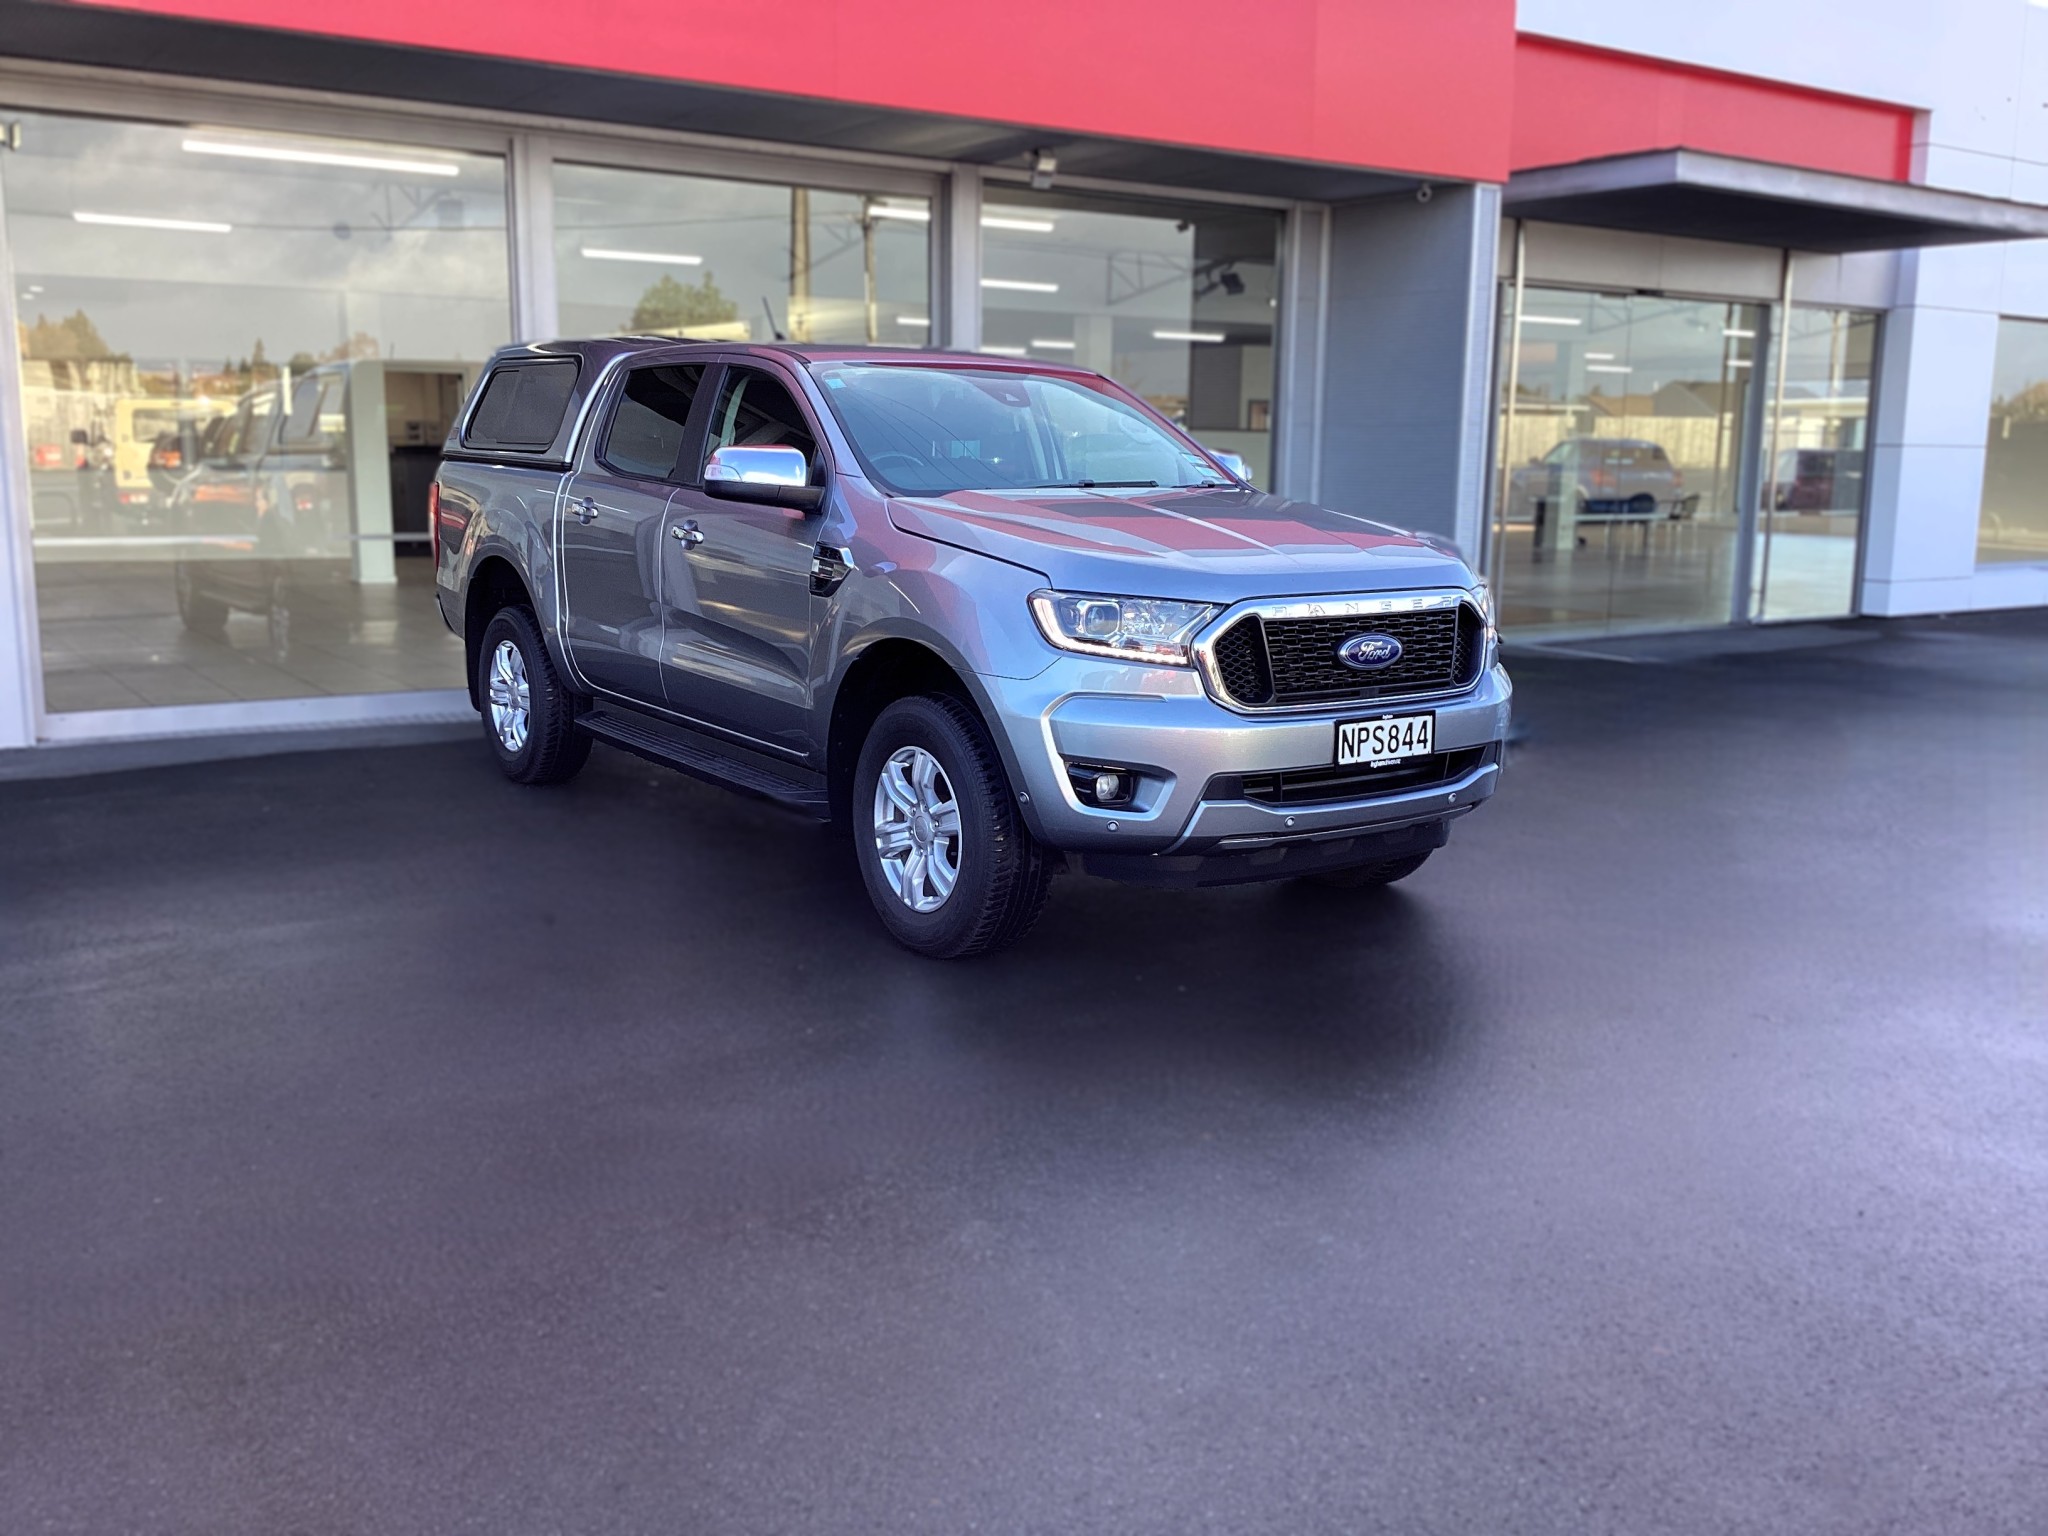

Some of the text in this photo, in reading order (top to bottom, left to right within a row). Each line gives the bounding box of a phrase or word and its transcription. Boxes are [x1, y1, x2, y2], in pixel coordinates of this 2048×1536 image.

[1272, 596, 1453, 616] RANGER
[1358, 641, 1391, 661] Ford
[1341, 720, 1428, 759] NPS844
